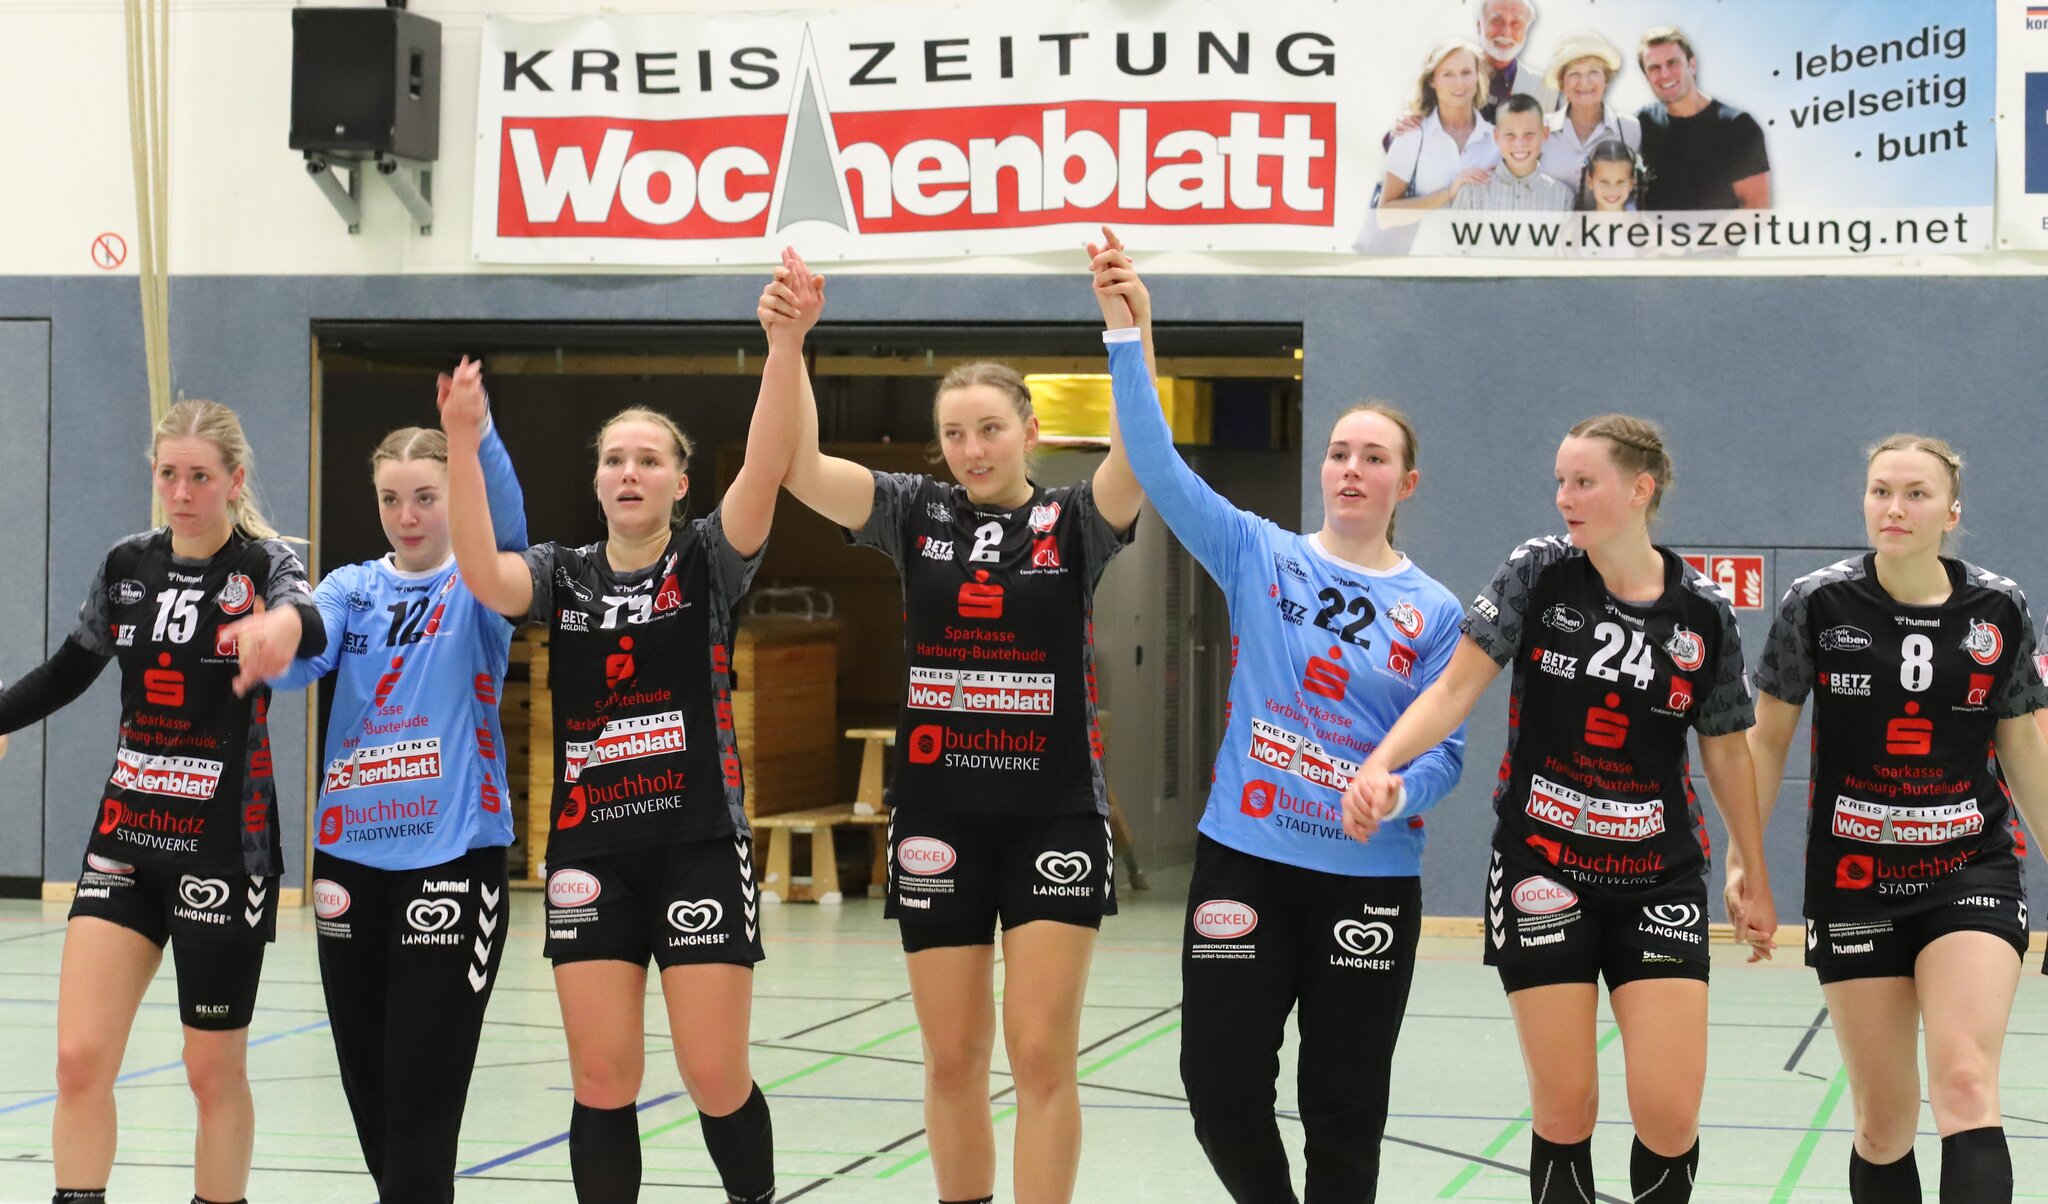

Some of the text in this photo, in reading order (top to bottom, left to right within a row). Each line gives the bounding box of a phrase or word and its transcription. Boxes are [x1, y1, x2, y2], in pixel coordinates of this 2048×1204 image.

[1795, 23, 1967, 81] lebendig
[503, 31, 1337, 95] KREIS ZEITUNG
[1789, 72, 1968, 130] vielseitig
[1877, 119, 1969, 163] bunt
[1451, 211, 1970, 254] www.kreiszeitung.net
[925, 536, 955, 555] BETZ
[969, 521, 1004, 563] 2
[1033, 549, 1059, 568] CR
[653, 590, 681, 611] CR
[151, 588, 205, 645] 15
[386, 596, 431, 648] 12
[1313, 586, 1377, 650] 22
[1905, 616, 1941, 628] hummel
[944, 626, 1015, 644] Sparkasse
[1835, 629, 1850, 637] wir
[1837, 634, 1868, 645] leben
[917, 642, 1047, 662] Harburg-Buxtehude
[1541, 649, 1579, 673] BETZ
[1585, 620, 1655, 691] 24
[1389, 653, 1411, 679] CR
[1540, 663, 1576, 680] HOLDING
[1900, 633, 1934, 692] 8
[911, 669, 1053, 684] KREIS ZEITUNG
[1830, 672, 1872, 689] BETZ
[910, 685, 1051, 712] Wochenblatt
[1669, 691, 1691, 712] CR
[1831, 687, 1872, 697] HOLDING
[135, 711, 192, 731] Sparkasse
[604, 713, 680, 732] EITUNG
[945, 726, 1047, 752] buchholz
[1252, 720, 1296, 744] KREIS
[945, 753, 1041, 772] STADTWERKE
[1572, 751, 1634, 774] Sparkasse
[1873, 764, 1945, 779] Sparkasse
[588, 769, 687, 806] buchholz
[1534, 777, 1582, 803] KREIS
[345, 795, 439, 826] buchholz
[591, 795, 683, 824] STADTWERKE
[1838, 798, 1975, 818] KREIS ZEITUNG
[116, 828, 199, 853] STADTWERKE
[346, 821, 435, 844] STADTWERKE
[902, 848, 947, 863] JOCKEL
[1563, 845, 1665, 874] buchholz
[422, 878, 470, 894] hummel
[551, 882, 592, 894] JOCKEL
[1032, 884, 1091, 897] LANGNESE
[899, 893, 931, 910] hummel
[1363, 903, 1400, 917] hummel
[174, 904, 226, 925] LANGNESE
[1199, 913, 1248, 925] JOCKEL
[401, 933, 460, 946] LANGNESE
[549, 926, 578, 940] hummel
[668, 933, 726, 947] LANGNESE
[1519, 928, 1566, 948] hummel
[1638, 922, 1699, 945] LANGNESE
[1832, 939, 1874, 955] hummel
[1330, 953, 1391, 971] LANGNESE
[195, 1004, 230, 1014] SELECT
